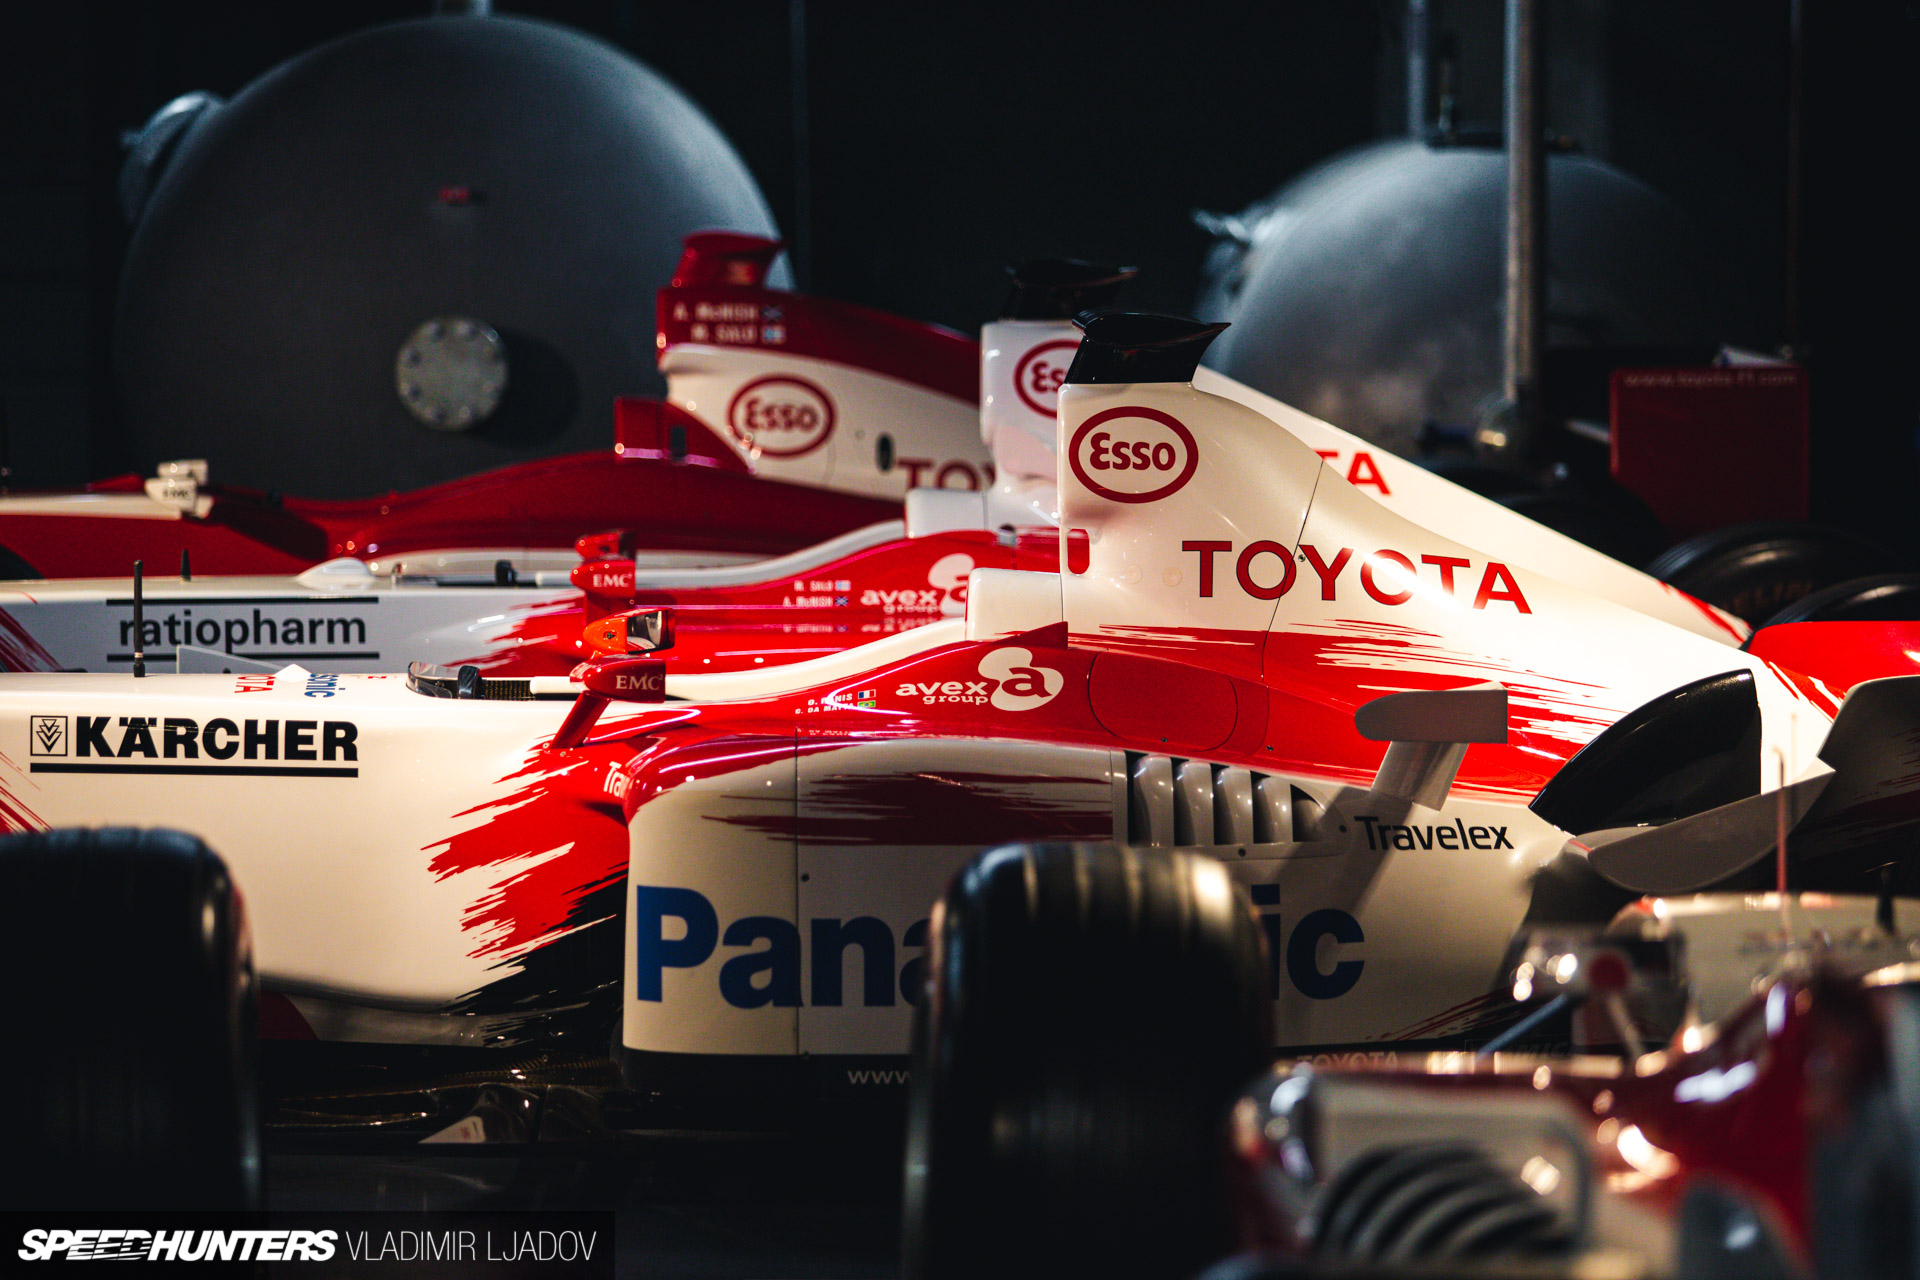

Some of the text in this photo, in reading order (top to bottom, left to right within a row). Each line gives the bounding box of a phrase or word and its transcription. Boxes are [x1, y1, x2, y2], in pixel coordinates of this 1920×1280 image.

[1032, 361, 1068, 392] Es
[744, 397, 819, 431] Esso
[1090, 432, 1176, 471] Esso
[1182, 539, 1533, 615] TOYOTA
[860, 589, 938, 606] avex
[119, 609, 367, 654] ratiopharm
[895, 681, 989, 697] avex
[922, 693, 989, 706] group
[76, 715, 359, 762] KÄRCHER
[1353, 816, 1515, 851] Travelex
